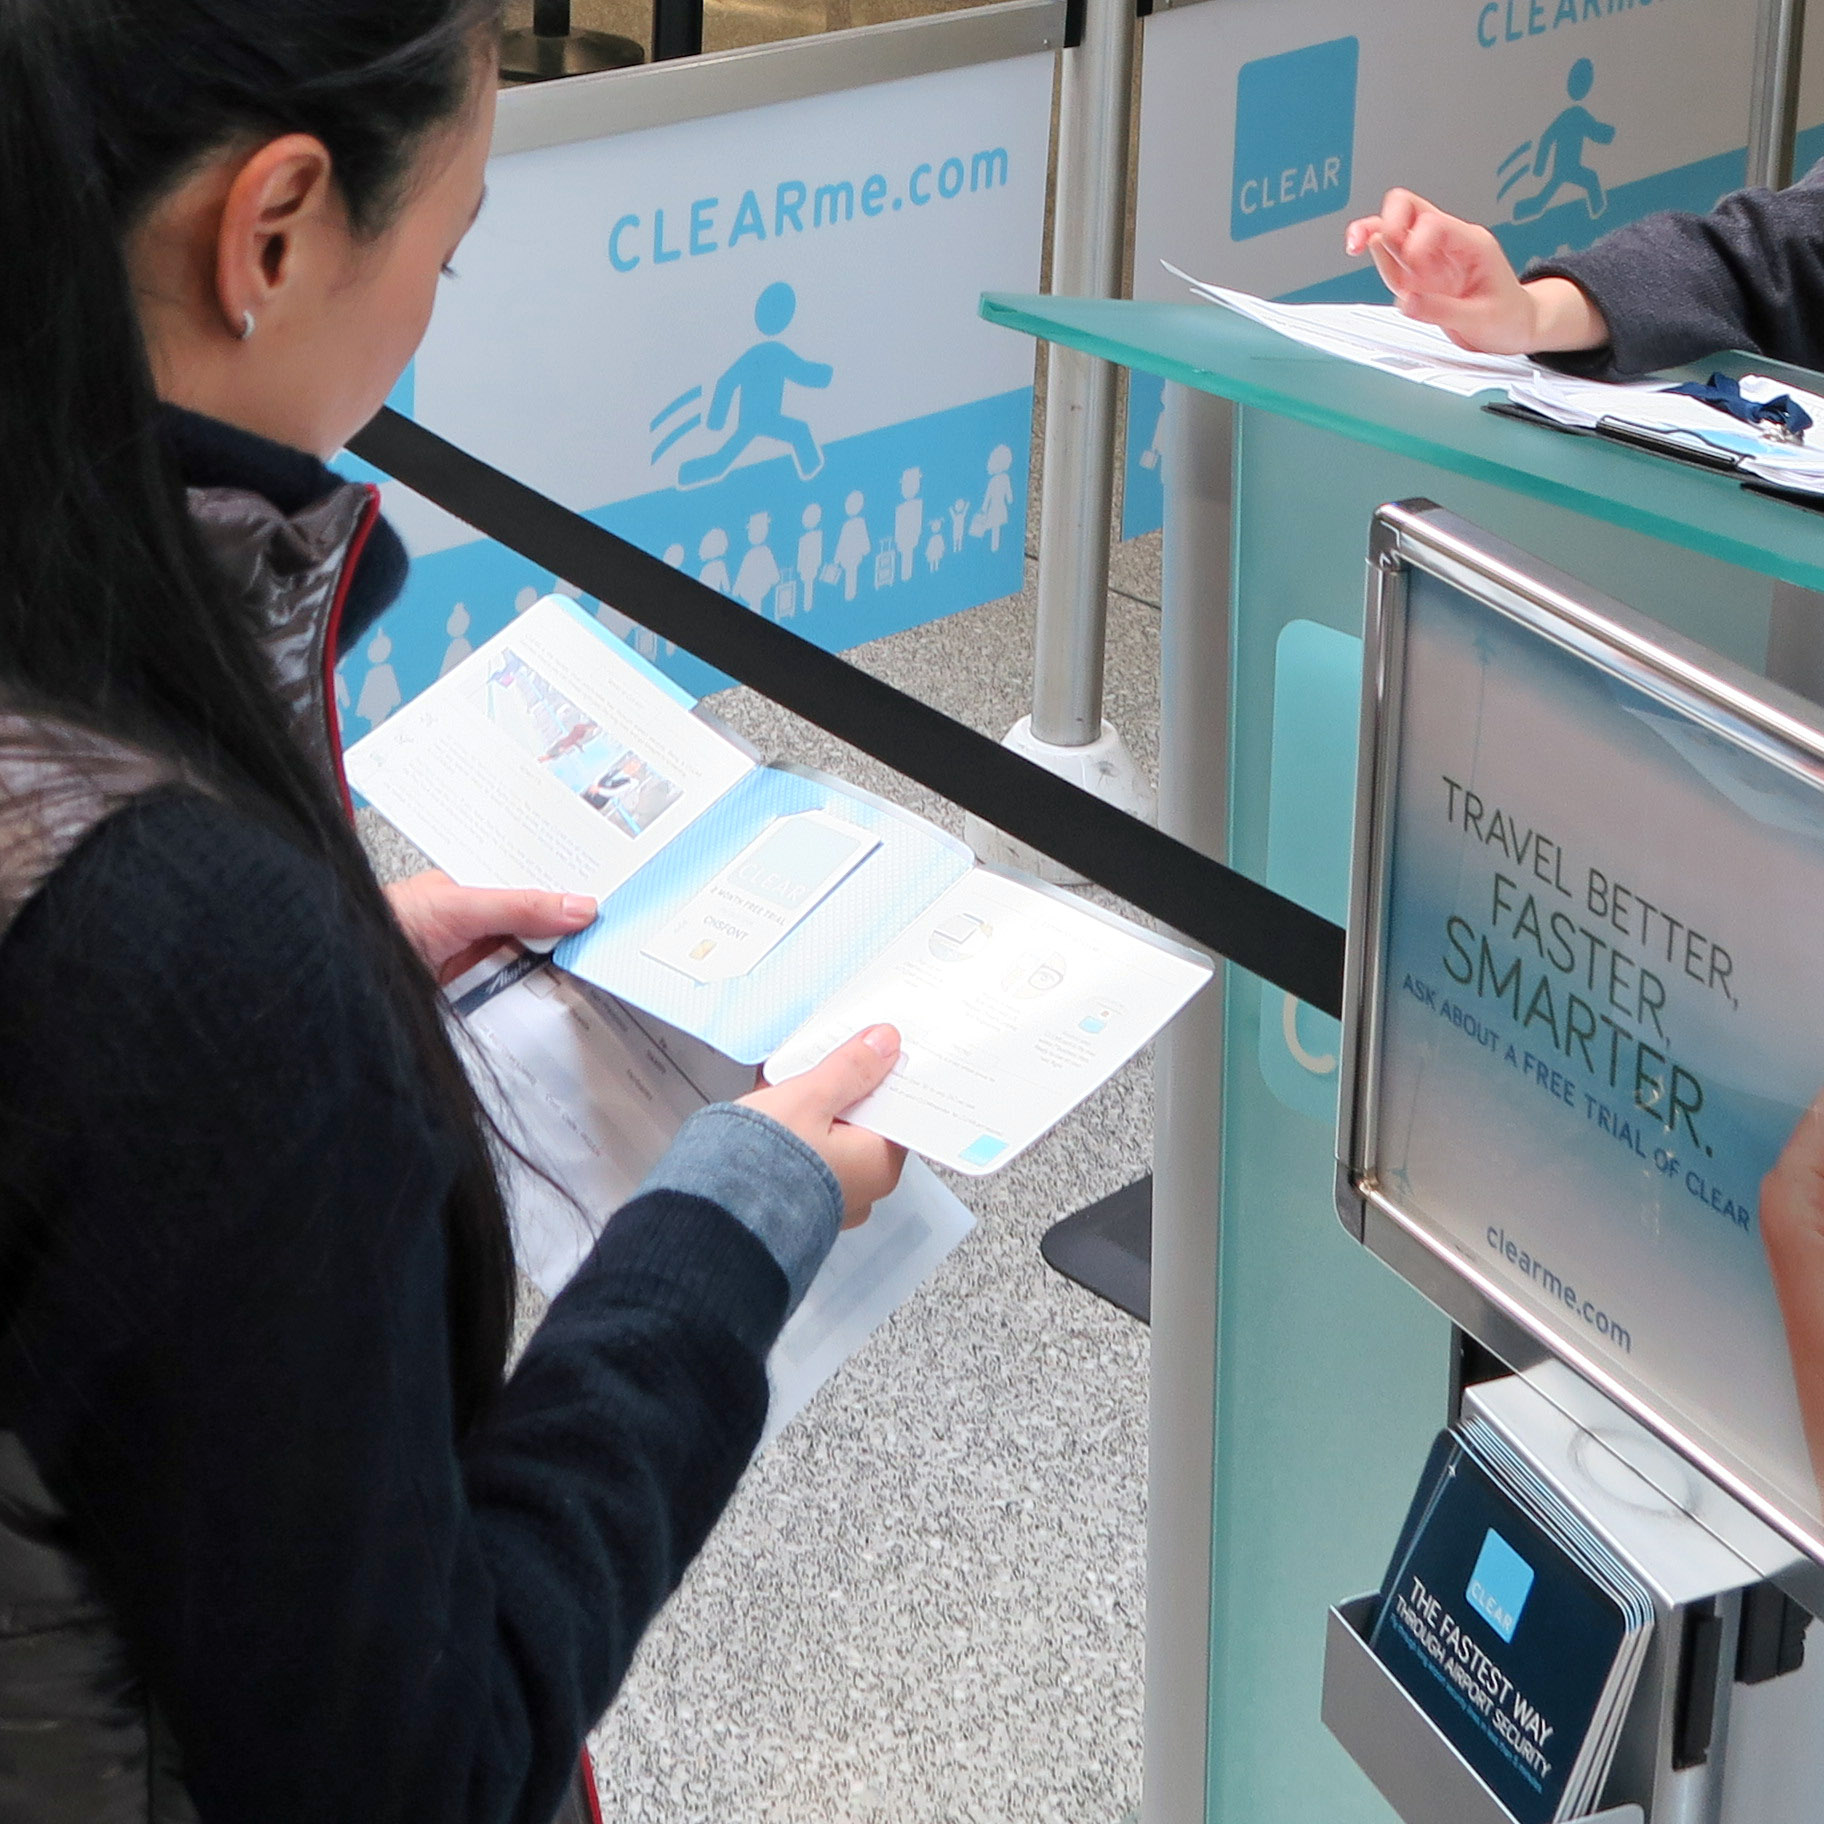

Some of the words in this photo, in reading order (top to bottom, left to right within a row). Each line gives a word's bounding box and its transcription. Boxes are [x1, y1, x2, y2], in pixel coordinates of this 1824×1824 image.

[607, 146, 1008, 273] CLEARme.com
[1239, 155, 1342, 216] CLEAR
[718, 887, 744, 908] MONTH
[742, 898, 764, 915] FREE
[763, 907, 787, 926] TRIAL
[1441, 775, 1572, 899] TRAVEL
[1587, 866, 1740, 1011] BETTER,
[1491, 872, 1672, 1048] FASTER,
[1402, 973, 1437, 1010] ASK
[1440, 1001, 1500, 1053] ABOUT
[1503, 1044, 1518, 1069] A
[1522, 1052, 1576, 1108] FREE
[1583, 1091, 1647, 1159] TRIAL
[1653, 1147, 1680, 1179] OF
[1685, 1170, 1751, 1232] CLEAR
[1442, 914, 1714, 1159] SMARTER.
[1486, 1224, 1632, 1354] clearme.com
[1395, 1593, 1447, 1665] THROUGH
[1443, 1657, 1496, 1717] AIRPORT
[1492, 1707, 1552, 1779] SECURITY
[1410, 1575, 1442, 1629] THE
[1439, 1613, 1514, 1704] FASTEST
[1513, 1692, 1554, 1747] WAY
[1470, 1580, 1514, 1633] CLEAR
